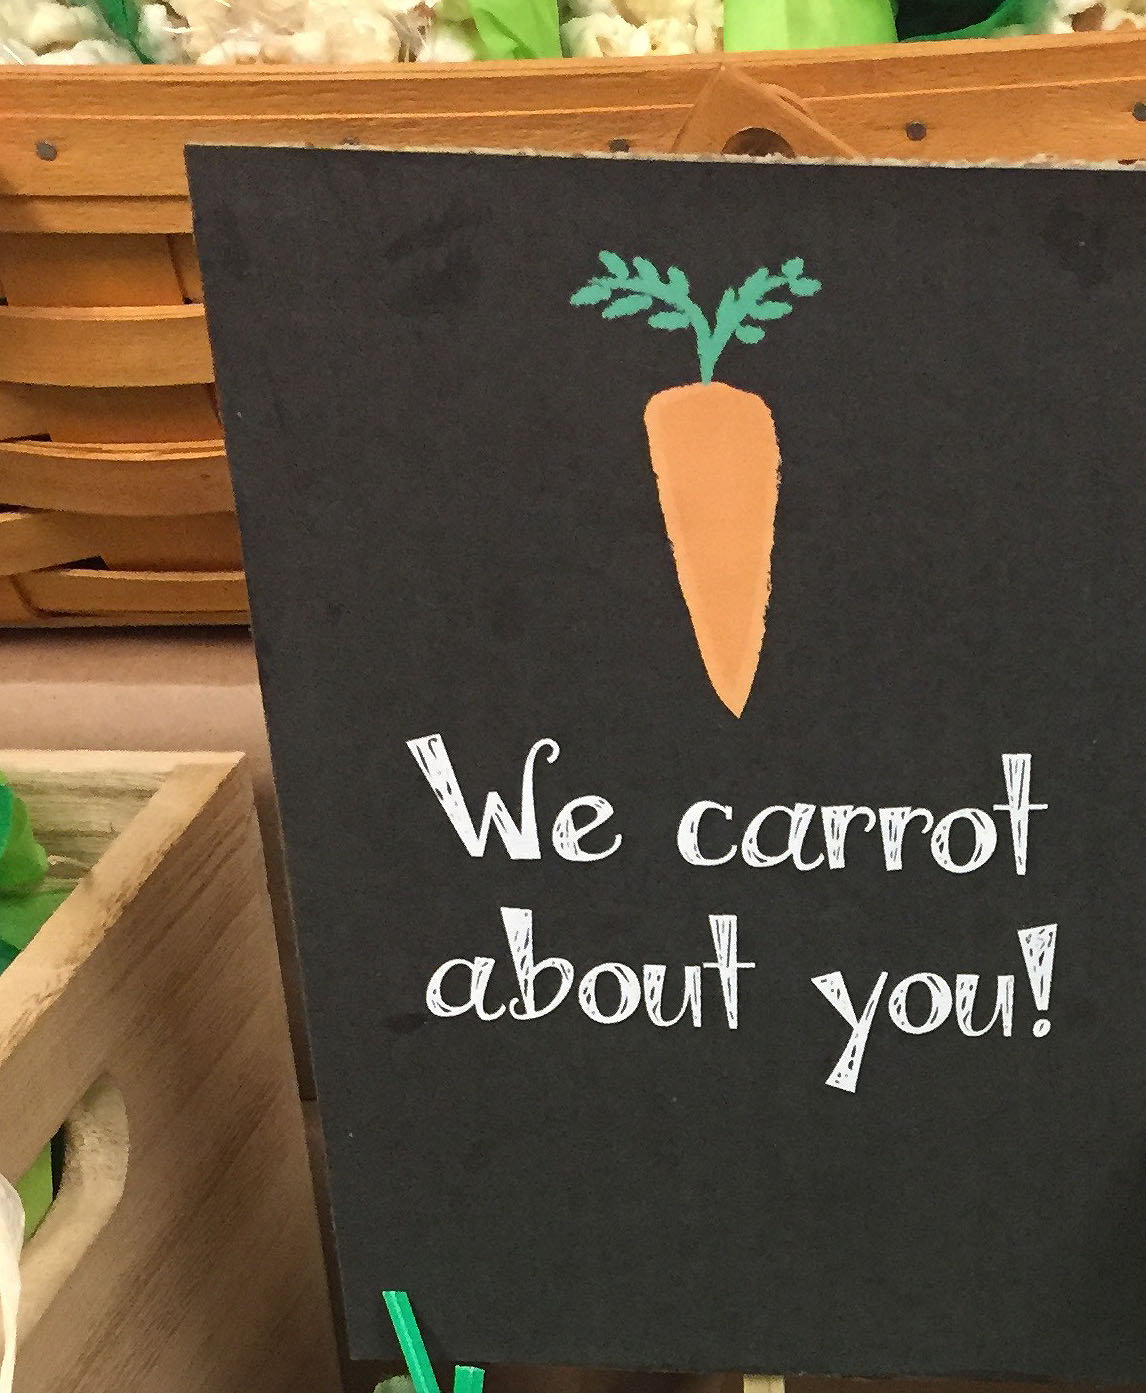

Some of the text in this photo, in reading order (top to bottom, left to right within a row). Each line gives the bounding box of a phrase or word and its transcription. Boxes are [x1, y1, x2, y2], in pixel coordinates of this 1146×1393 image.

[405, 733, 1049, 876] We carrot
[425, 906, 1058, 1094] about you!
